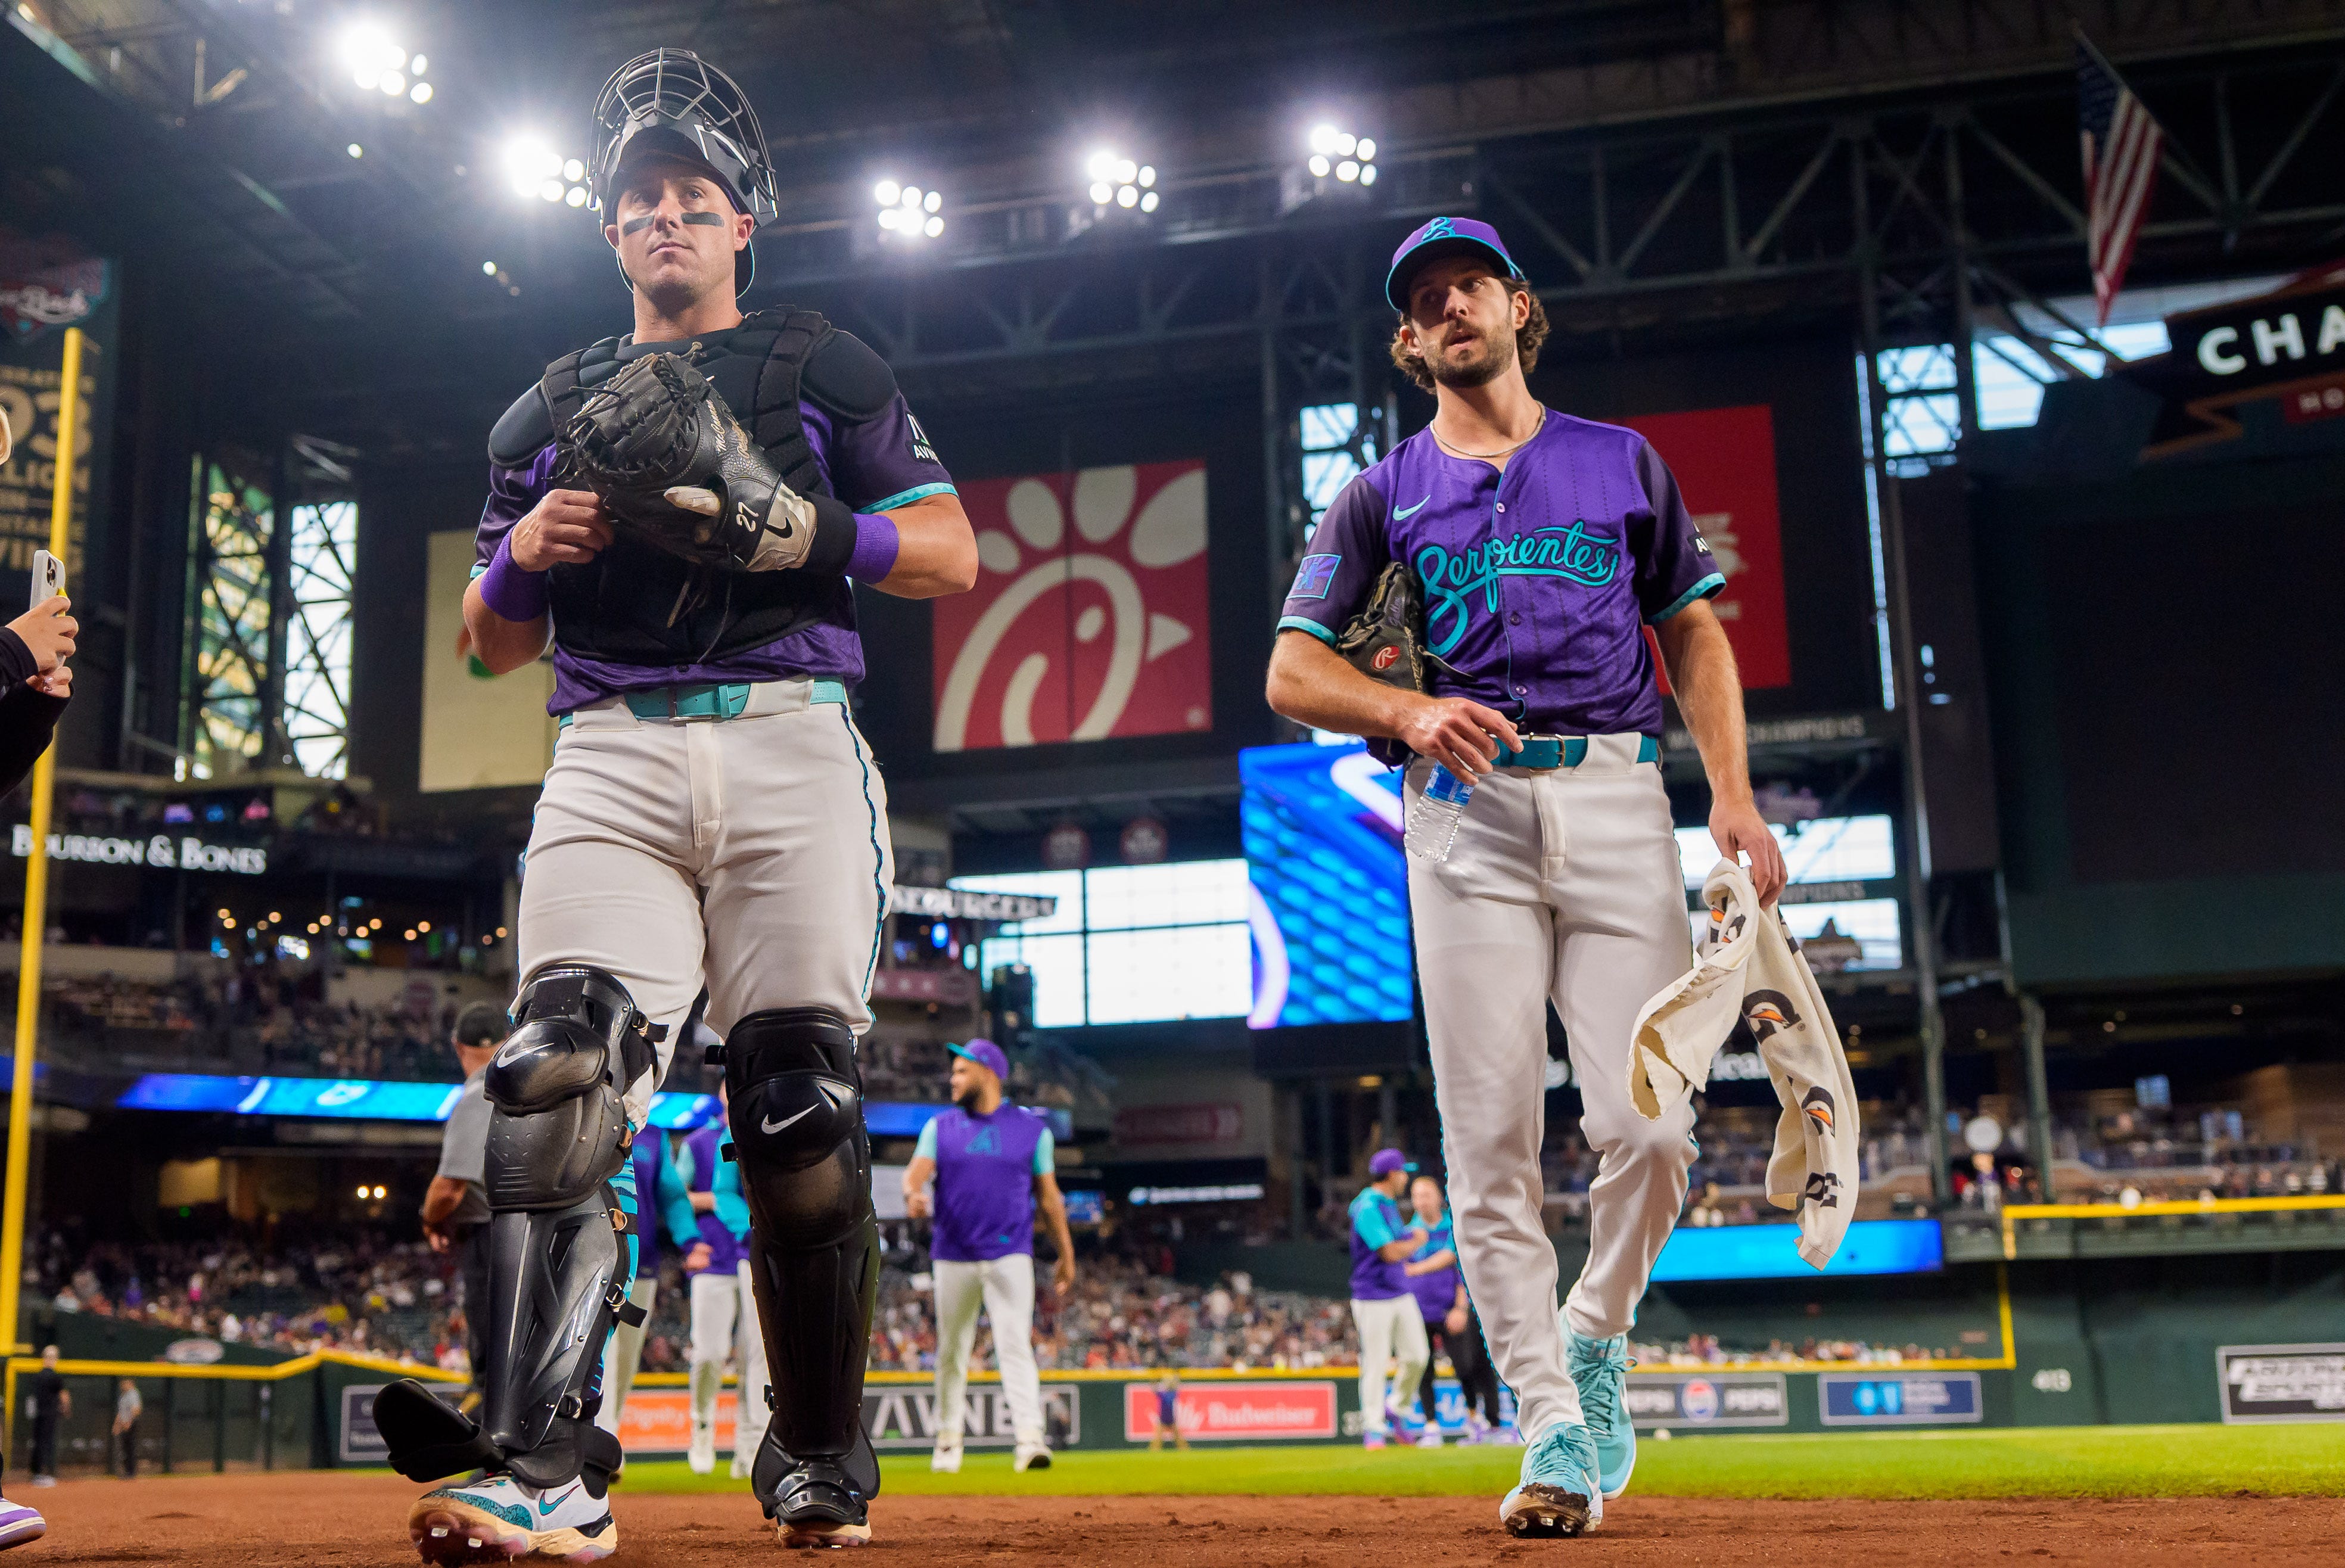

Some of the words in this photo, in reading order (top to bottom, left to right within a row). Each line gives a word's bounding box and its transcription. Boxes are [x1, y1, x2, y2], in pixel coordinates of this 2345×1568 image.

[2197, 306, 2345, 375] CHA
[736, 502, 758, 532] 27
[1417, 521, 1618, 656] Serpientes
[147, 835, 176, 867] &
[181, 837, 266, 874] BONES
